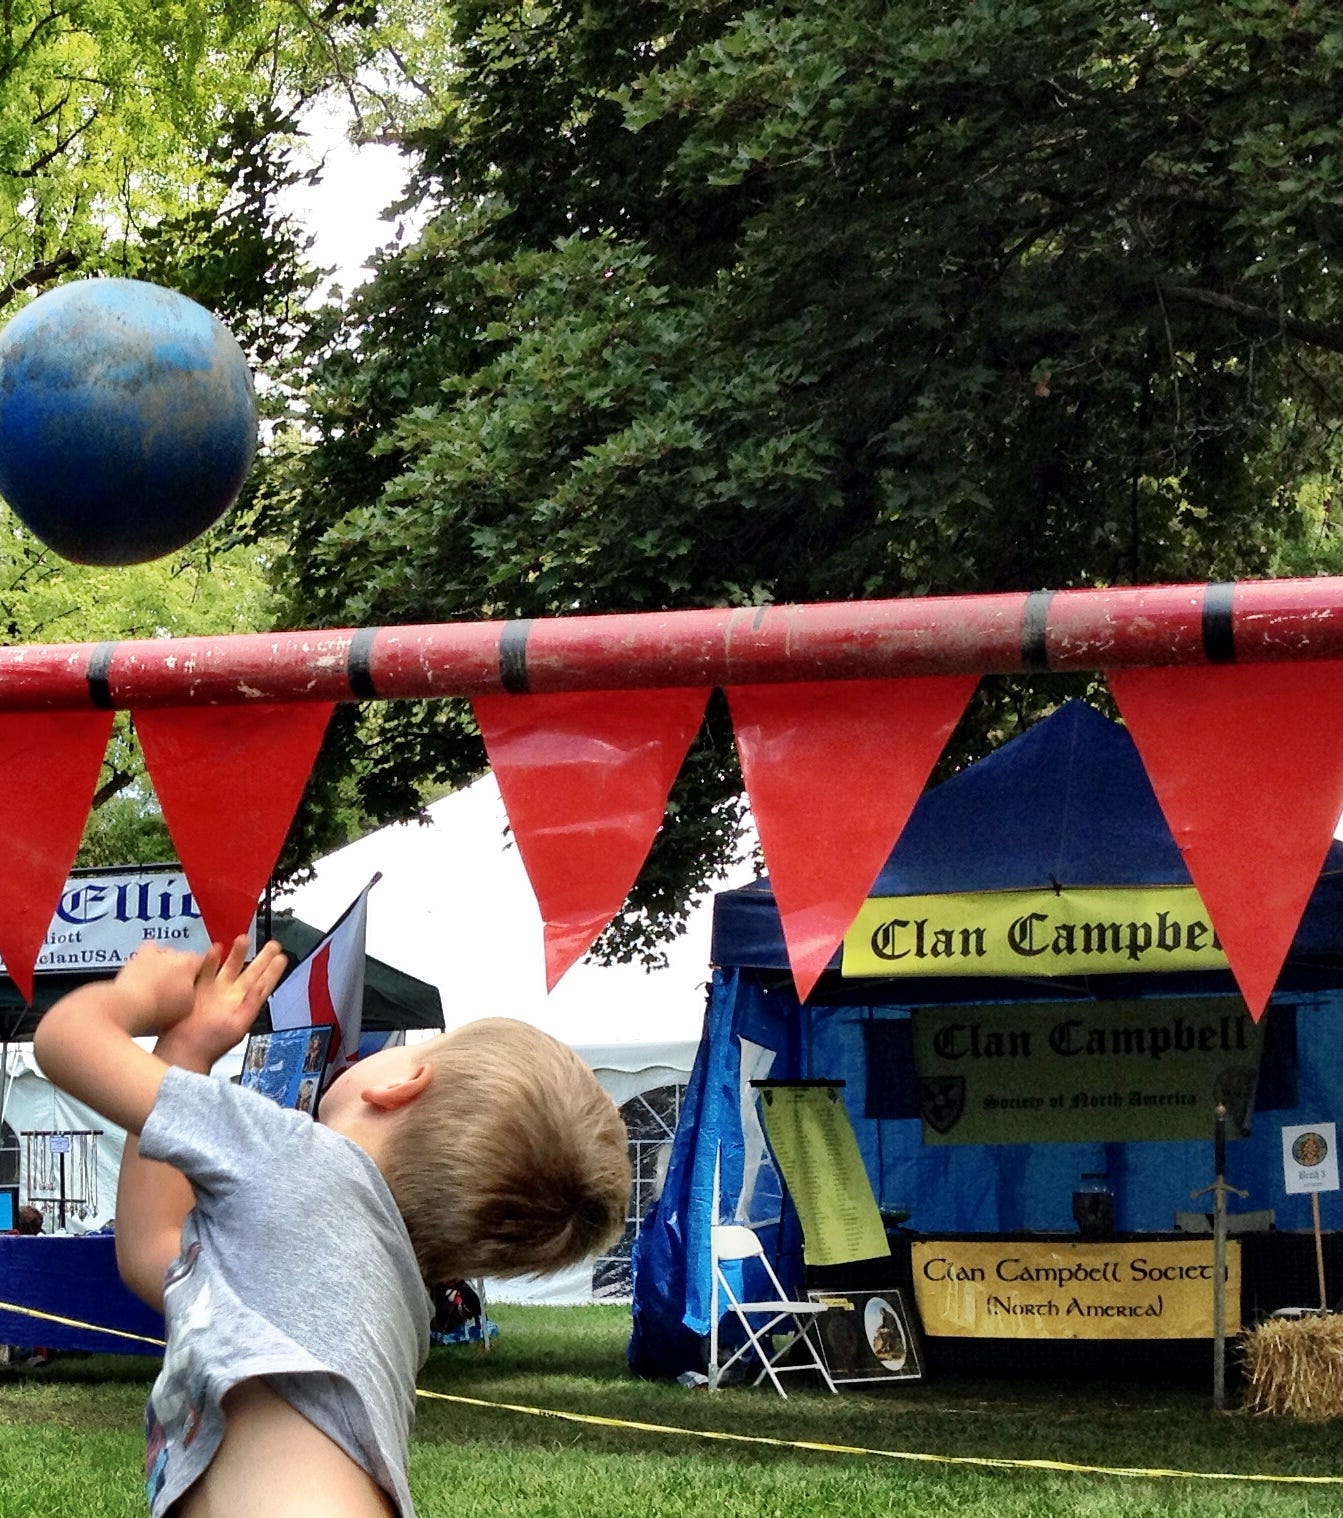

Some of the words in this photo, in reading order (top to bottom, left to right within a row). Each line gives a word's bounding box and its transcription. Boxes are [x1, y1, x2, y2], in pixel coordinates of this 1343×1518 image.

[56, 879, 203, 925] Ellio
[141, 926, 190, 940] Eliot
[870, 918, 987, 960] Clan
[1007, 911, 1224, 961] Campbe
[932, 1022, 1032, 1061] Clan
[1048, 1015, 1249, 1060] Campbell
[982, 1094, 1044, 1111] Society
[1049, 1093, 1065, 1108] of
[1070, 1091, 1123, 1109] North
[1127, 1090, 1197, 1107] America
[923, 1257, 985, 1282] Clan
[995, 1257, 1122, 1288] Campbell
